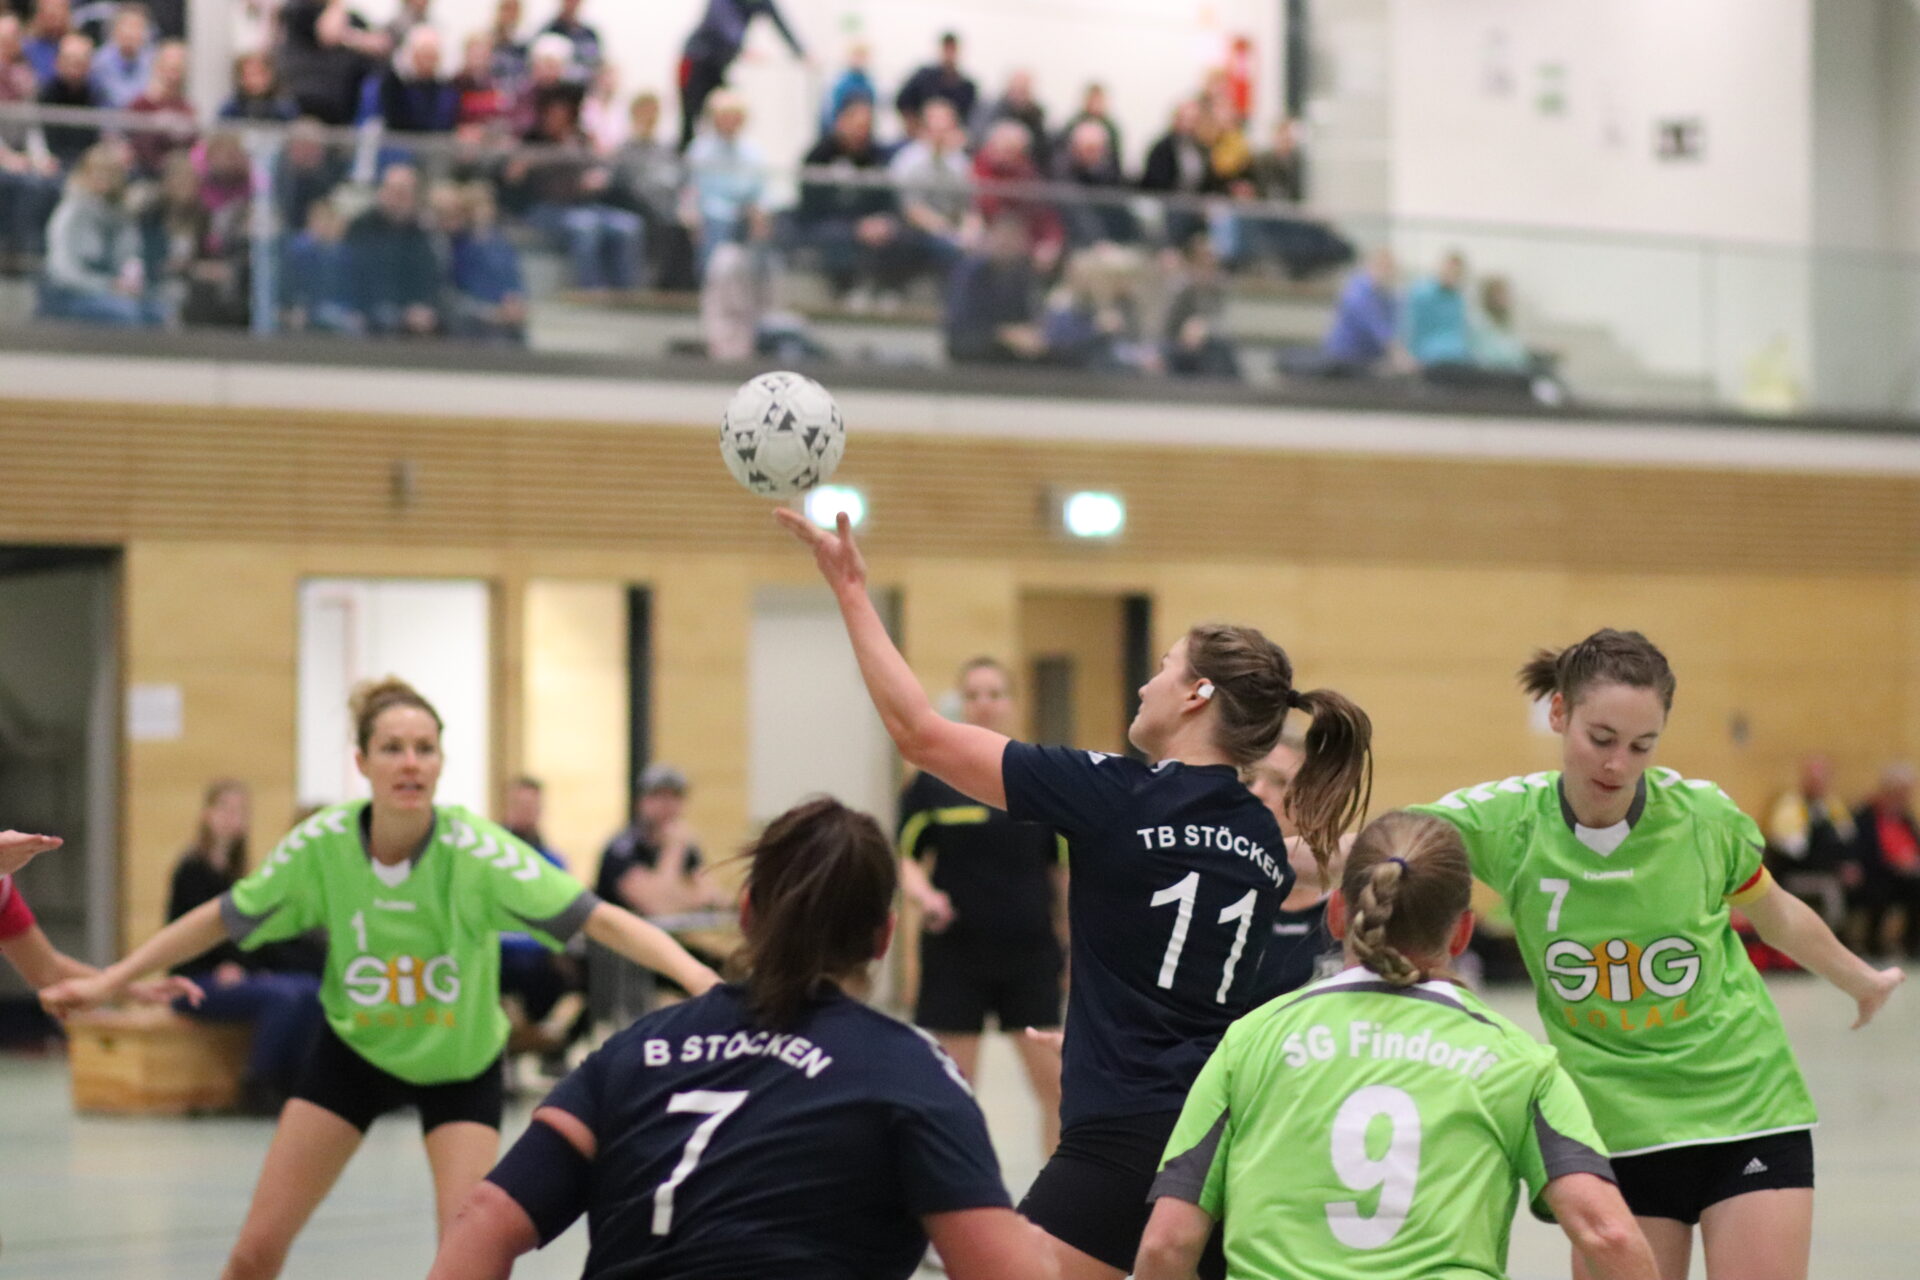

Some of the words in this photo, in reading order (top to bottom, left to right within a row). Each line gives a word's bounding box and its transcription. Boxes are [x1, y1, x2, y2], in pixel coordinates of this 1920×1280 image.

[1137, 825, 1177, 849] TB
[1184, 825, 1284, 888] STÖCKEN
[350, 911, 369, 951] 1
[1540, 878, 1570, 932] 7
[1150, 871, 1258, 1004] 11
[1282, 1025, 1336, 1068] SG
[1350, 1021, 1499, 1080] Findorff
[652, 1090, 749, 1235] 7
[1325, 1085, 1421, 1249] 9
